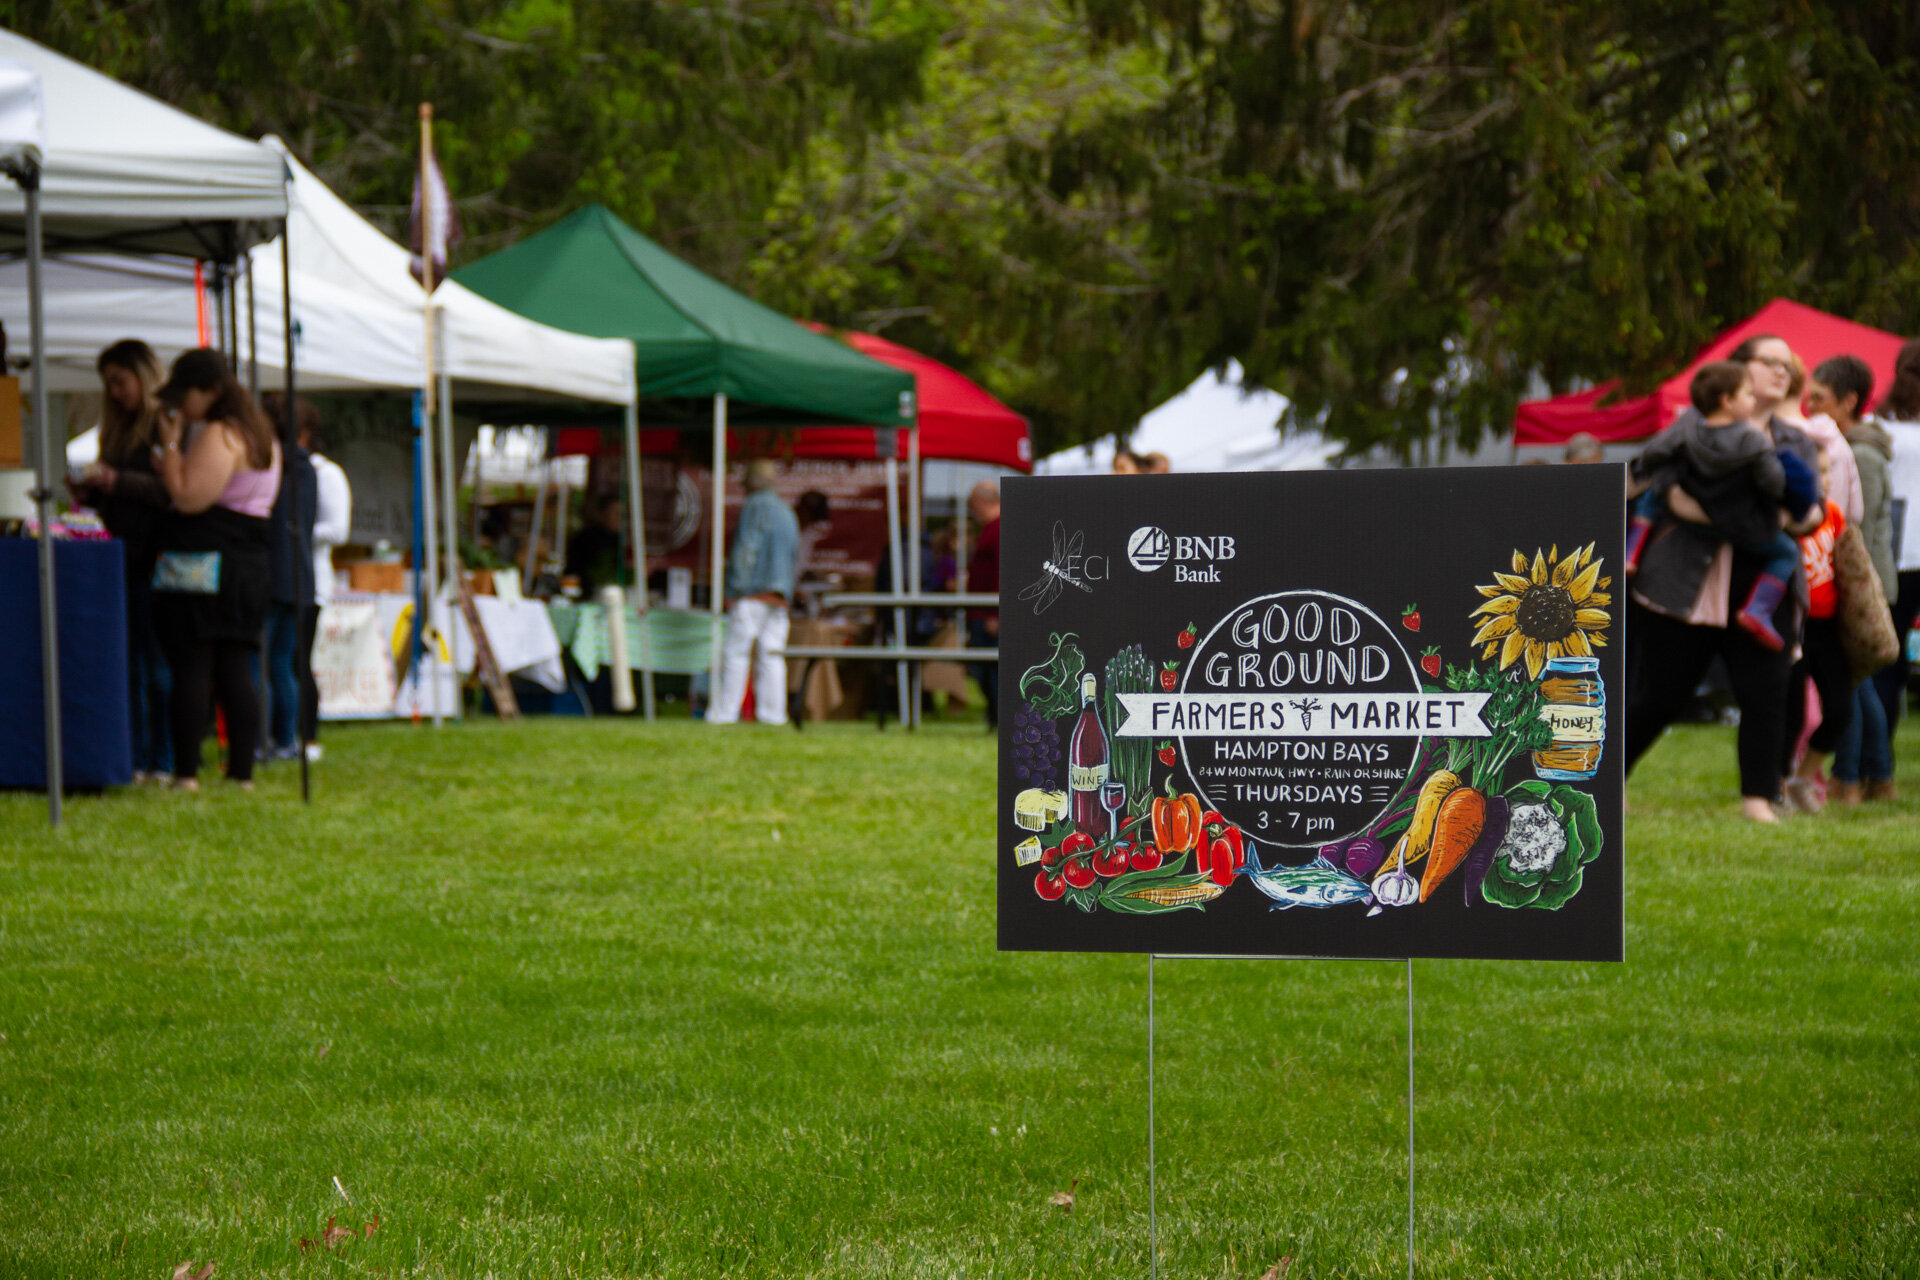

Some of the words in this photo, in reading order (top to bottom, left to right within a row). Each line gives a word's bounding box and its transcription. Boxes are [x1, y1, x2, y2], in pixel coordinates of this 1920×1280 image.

[1174, 536, 1236, 560] BNB
[1066, 555, 1110, 581] ECI
[1174, 564, 1221, 583] Bank
[1232, 602, 1361, 649] GOOD
[1205, 645, 1391, 688] GROUND
[1152, 702, 1286, 731] FARMERS
[1330, 700, 1466, 730] MARKET
[1550, 713, 1594, 733] HONEY
[1214, 740, 1326, 761] HAMPTON
[1333, 743, 1390, 764] BAYS
[1072, 774, 1103, 786] WINE
[1228, 766, 1285, 779] MONTAUK
[1288, 768, 1315, 779] HWY
[1324, 768, 1350, 779] RAIN
[1233, 784, 1363, 804] THURSDAYS
[1306, 814, 1335, 836] pm
